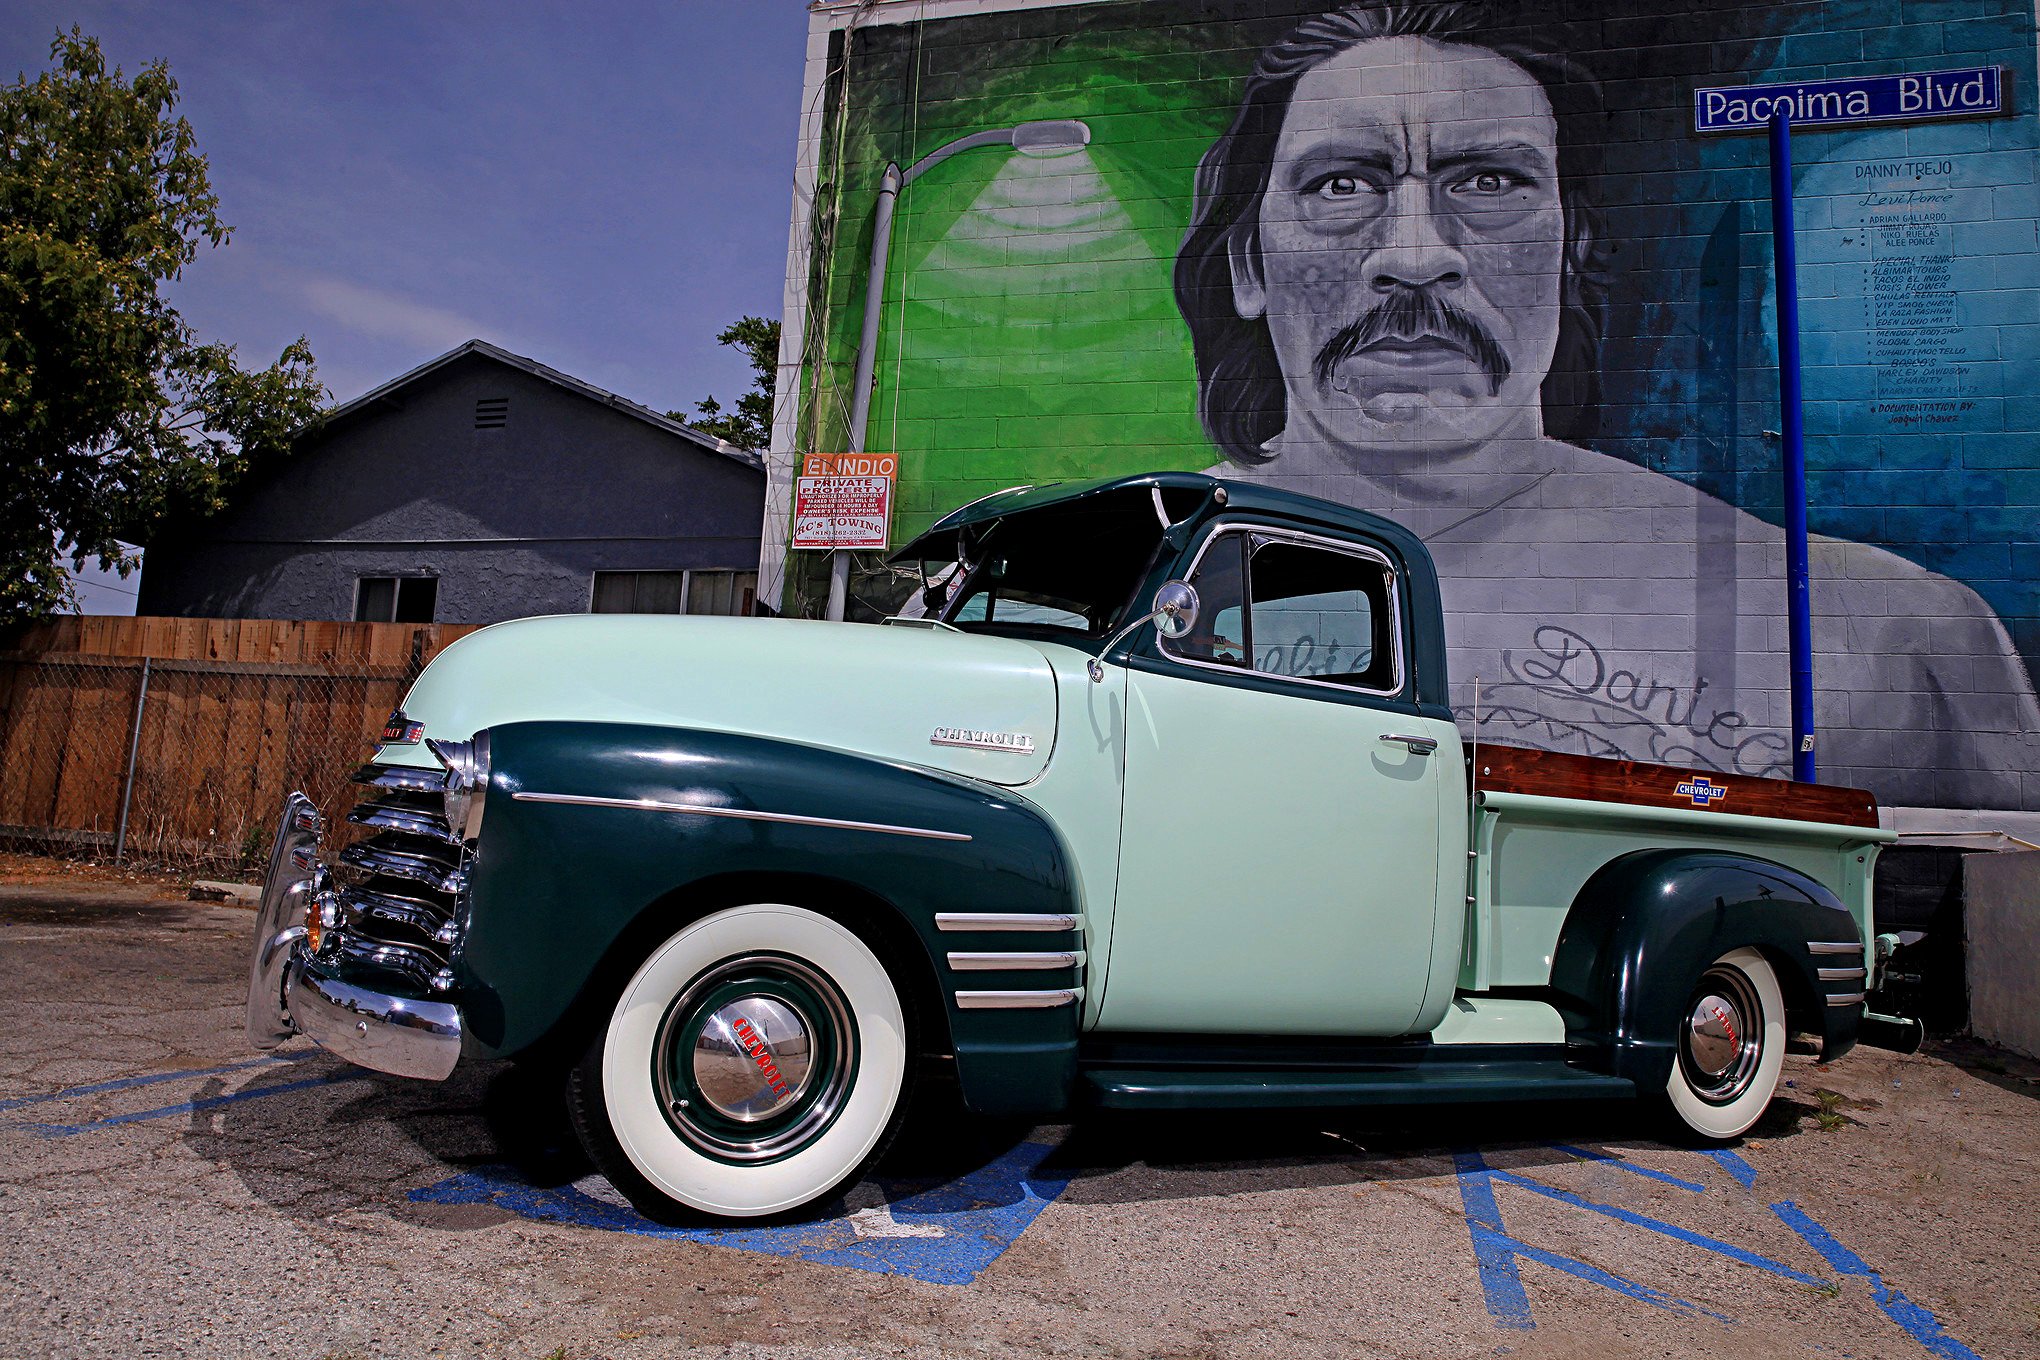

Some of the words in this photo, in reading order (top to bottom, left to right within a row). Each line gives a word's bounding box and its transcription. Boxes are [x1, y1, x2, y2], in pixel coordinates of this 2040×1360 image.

[1706, 88, 1870, 124] Pacoima
[1899, 72, 1993, 113] Blvd.
[1855, 164, 1903, 179] DANNY
[1905, 161, 1952, 177] TREJO
[1858, 192, 1905, 206] Levi
[1906, 190, 1954, 204] Ponce
[1869, 215, 1900, 224] ADRIAN
[1902, 213, 1947, 223] GALLARDO
[1880, 231, 1901, 239] NIKO
[1906, 230, 1940, 239] RUELAS
[1908, 238, 1935, 246] PONCE
[1873, 255, 1916, 267] SPECIAL
[1919, 253, 1957, 265] THANKS
[1871, 267, 1913, 276] ALBIMAR
[1916, 265, 1949, 274] TOURS
[1873, 275, 1905, 284] TACOS
[1907, 275, 1920, 283] EL
[1923, 274, 1951, 282] INDIO
[1905, 282, 1947, 291] FLOWER
[1874, 292, 1911, 301] CHULAS
[1875, 301, 1894, 309] VIP
[1897, 301, 1925, 309] SMOG
[1925, 299, 1955, 308] CHECK
[1875, 309, 1887, 317] LA
[1889, 309, 1912, 317] RAZA
[1913, 308, 1952, 316] FASHION
[1876, 319, 1899, 327] EDEN
[1876, 329, 1918, 337] MENDOZA
[1919, 328, 1940, 337] BODY
[1941, 327, 1964, 335] SHOP
[1876, 338, 1911, 346] GLOBAL
[1914, 337, 1948, 346] CARGO
[1938, 347, 1967, 355] TELLO
[1877, 368, 1919, 377] HARLEY
[1921, 367, 1971, 376] DAVIDSON
[1895, 376, 1944, 385] CHARITY
[1878, 402, 1957, 413] DOCUMENTATION
[1925, 413, 1960, 423] Chavez
[807, 458, 834, 475] EL
[837, 457, 895, 476] INDIO
[813, 479, 873, 487] PRIVATE
[802, 486, 884, 494] PROPERTY
[827, 517, 882, 534] TOWING
[933, 727, 1033, 748] CHEVROLET
[1679, 784, 1722, 797] CHEVROLET
[732, 1017, 792, 1101] CHEVROLET
